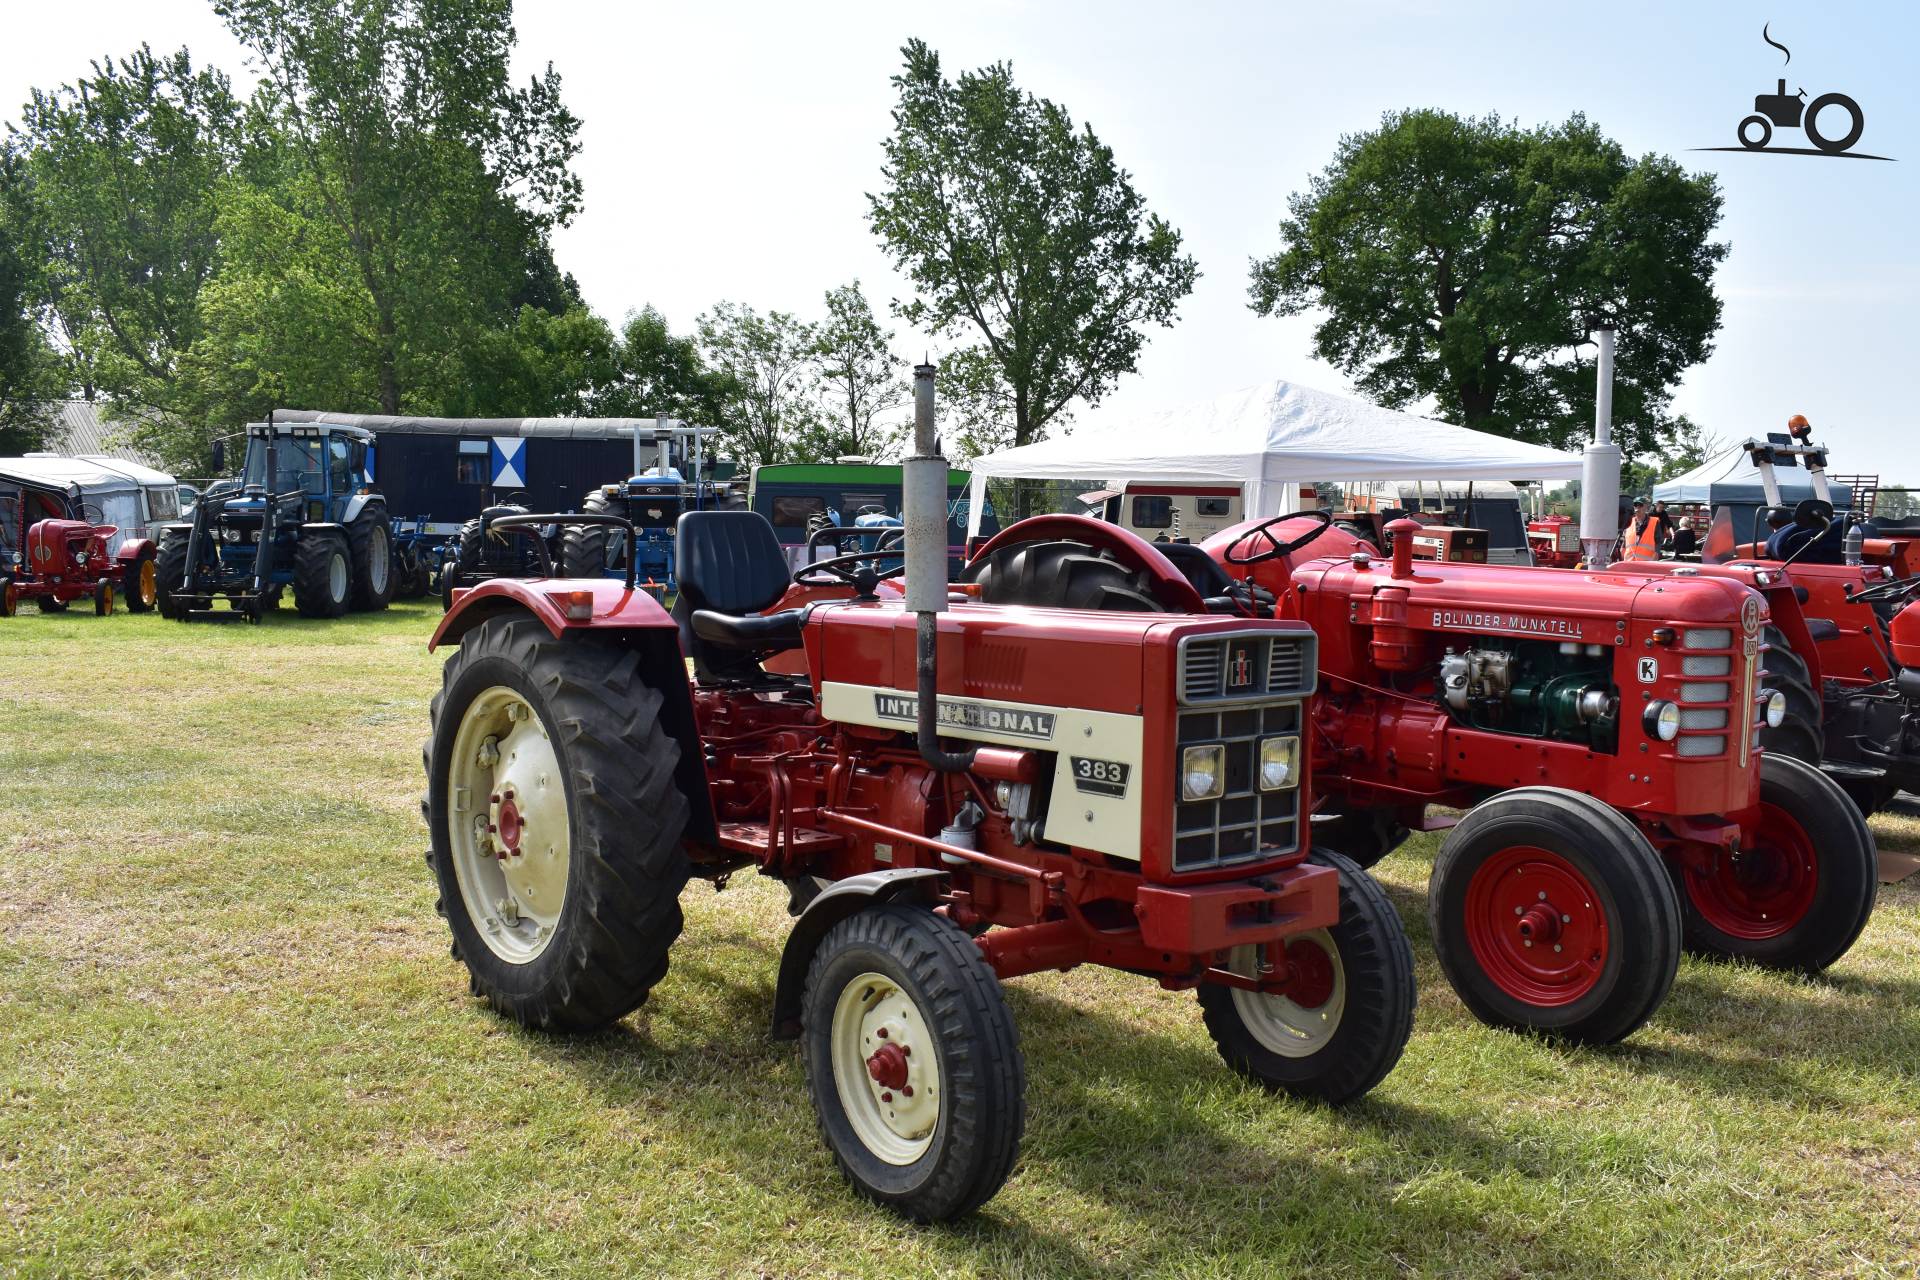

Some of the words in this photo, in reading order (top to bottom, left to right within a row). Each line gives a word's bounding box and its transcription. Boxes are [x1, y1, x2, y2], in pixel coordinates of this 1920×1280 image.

[1433, 612, 1582, 635] BOLINDER-MUNKTELL
[1641, 662, 1653, 678] K
[880, 698, 1049, 733] INTENATIONAL
[1079, 759, 1121, 782] 383
